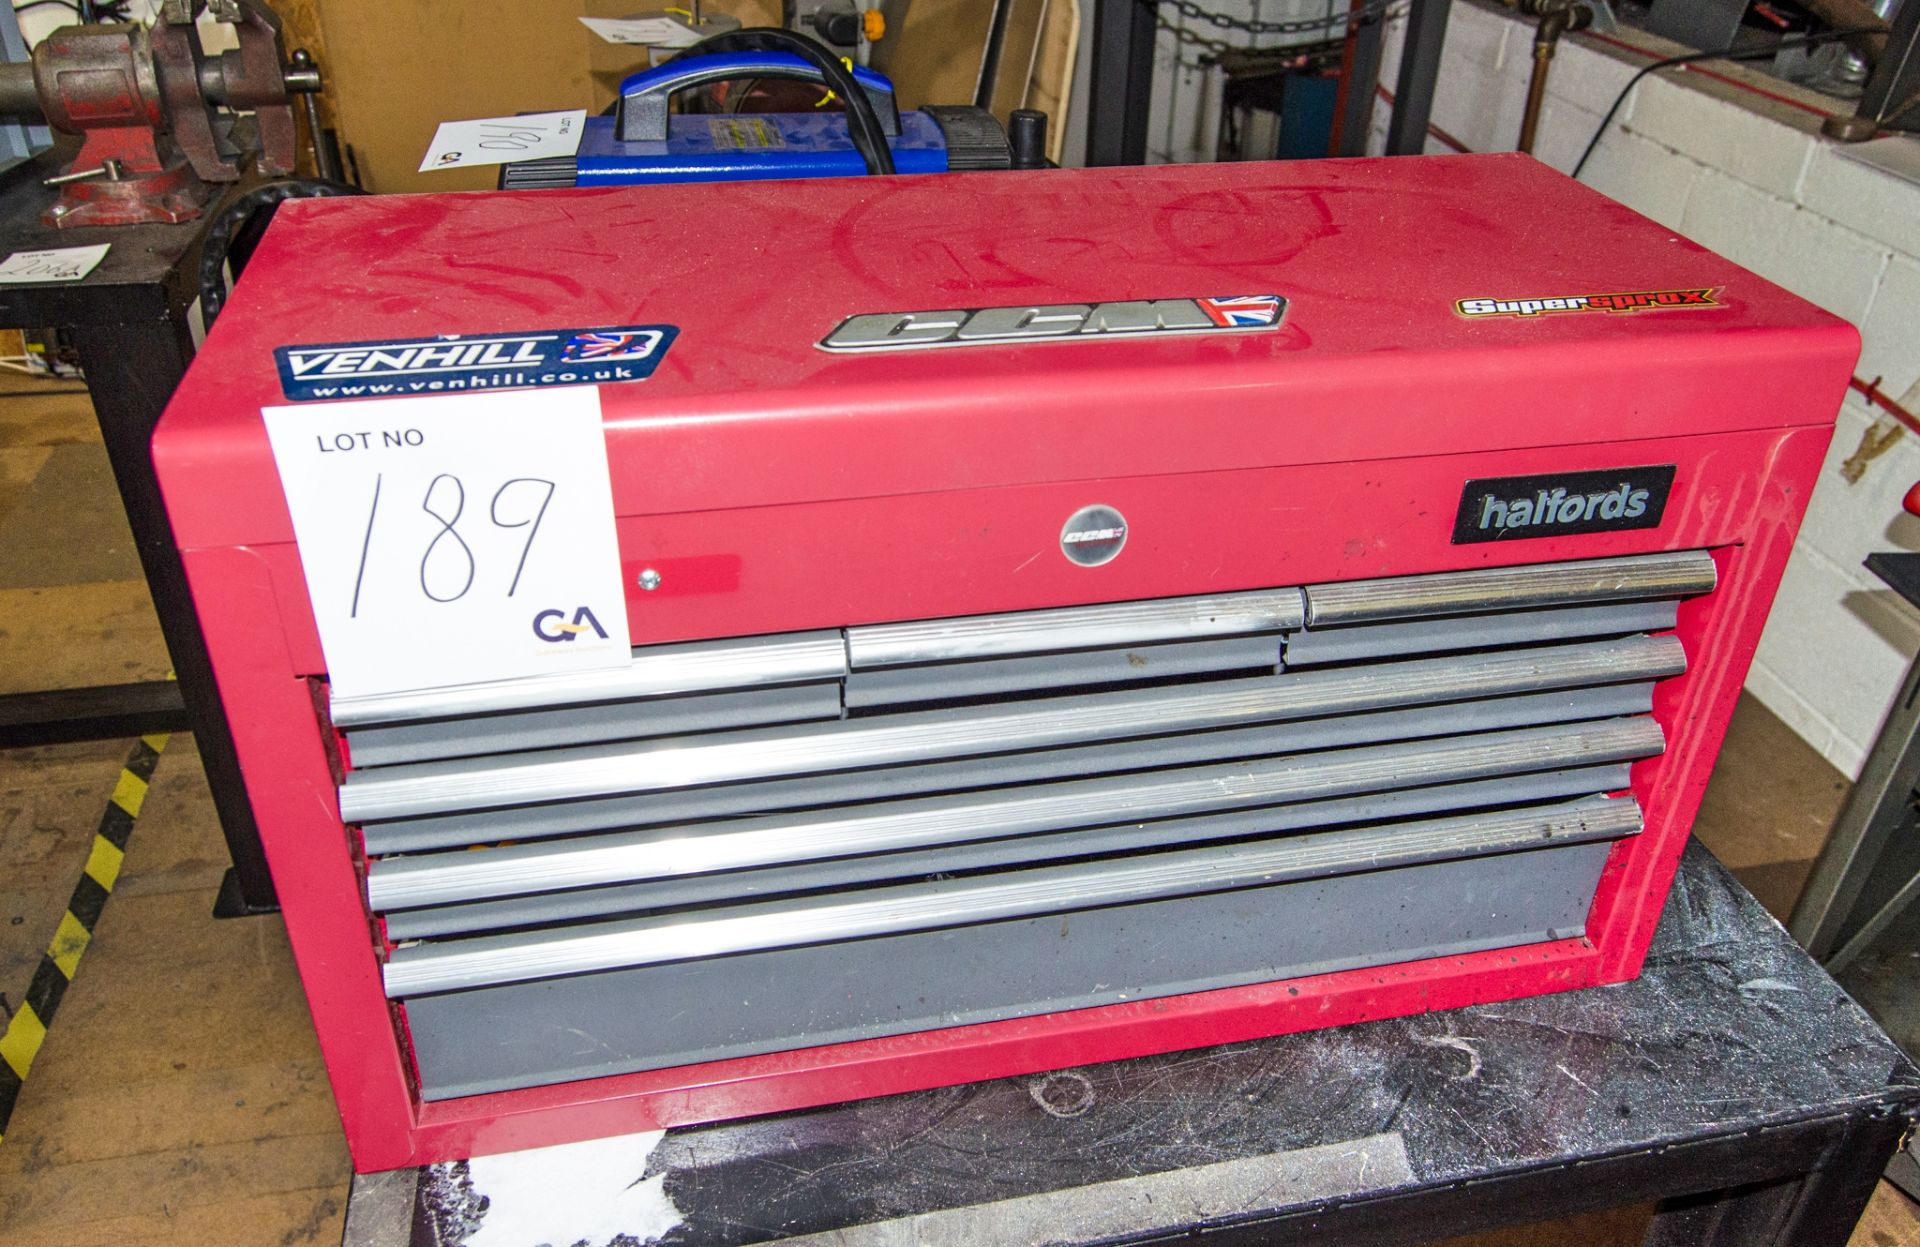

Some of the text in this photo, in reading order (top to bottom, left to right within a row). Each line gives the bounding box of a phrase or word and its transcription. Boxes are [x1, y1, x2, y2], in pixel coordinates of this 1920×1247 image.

[479, 123, 548, 150] 190
[825, 298, 1215, 347] CCM
[288, 341, 546, 376] VENHILL
[312, 366, 633, 398] www.venhill.co.uk
[316, 428, 425, 453] LOT NO
[1478, 481, 1651, 531] halfords
[350, 472, 556, 619] 189
[532, 605, 610, 643] GA
